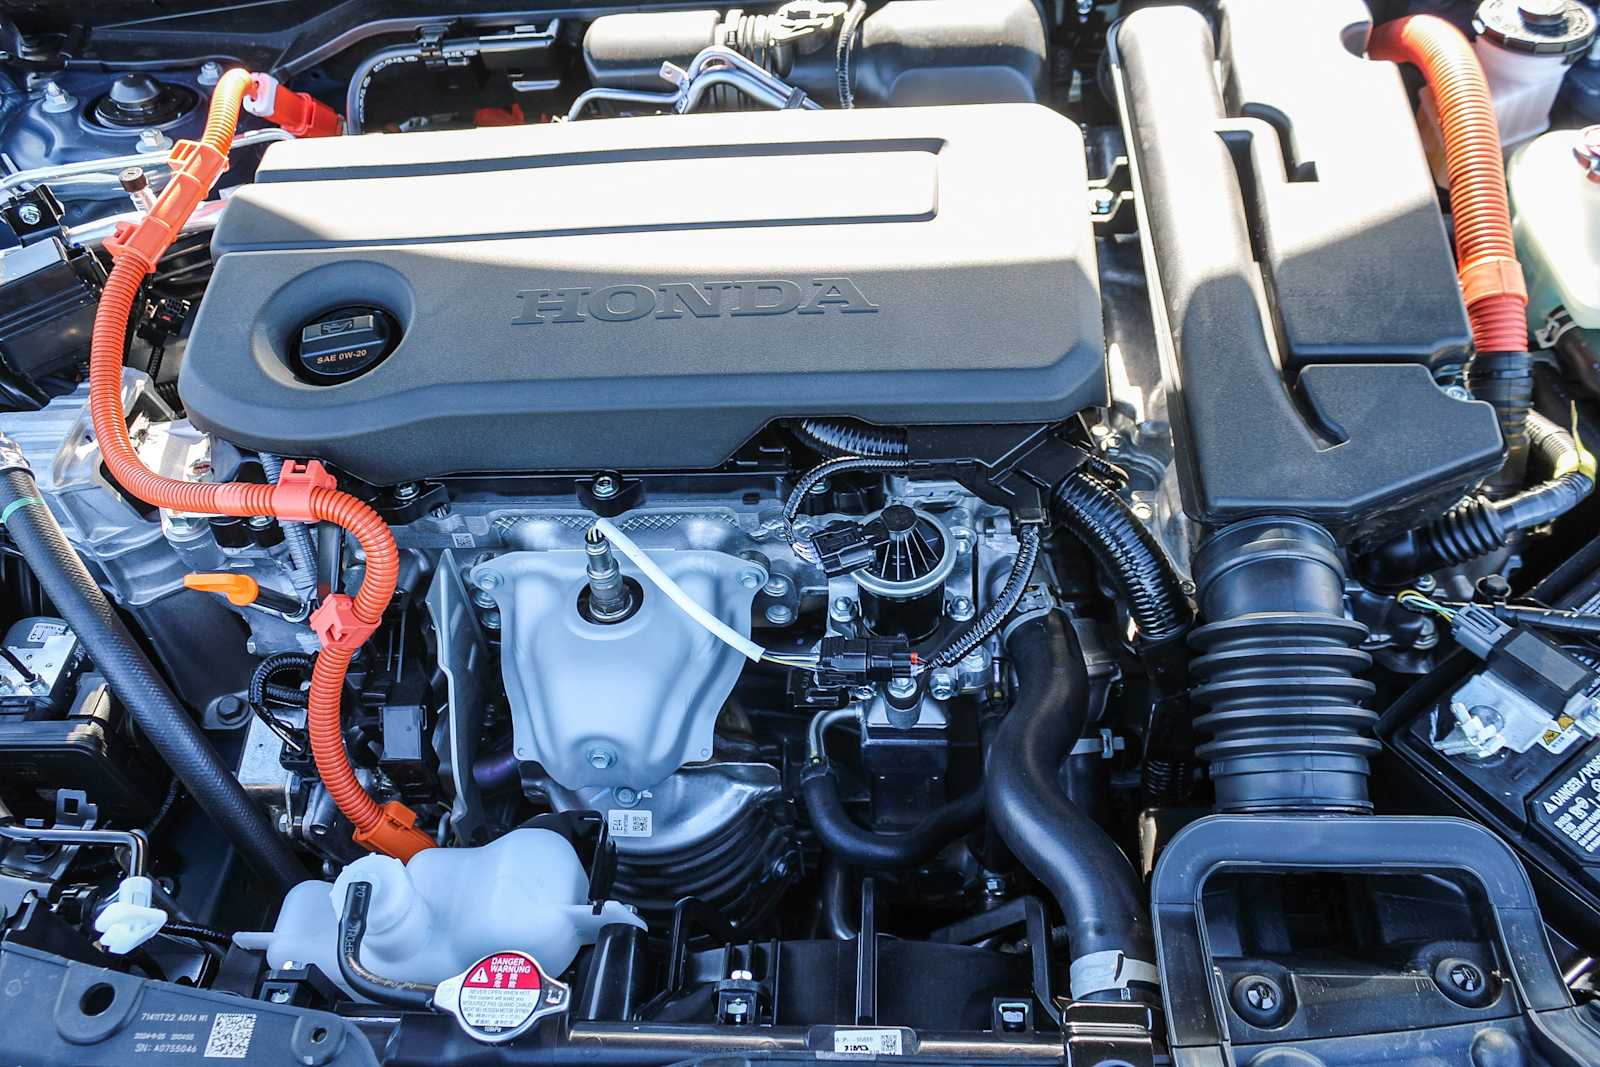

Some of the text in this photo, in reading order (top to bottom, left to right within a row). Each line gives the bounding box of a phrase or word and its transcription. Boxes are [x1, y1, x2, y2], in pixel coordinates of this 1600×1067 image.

[511, 278, 880, 325] HONDA
[316, 349, 368, 364] SAE 0W-20
[491, 957, 525, 966] DANGER
[490, 965, 531, 974] WARNUNG
